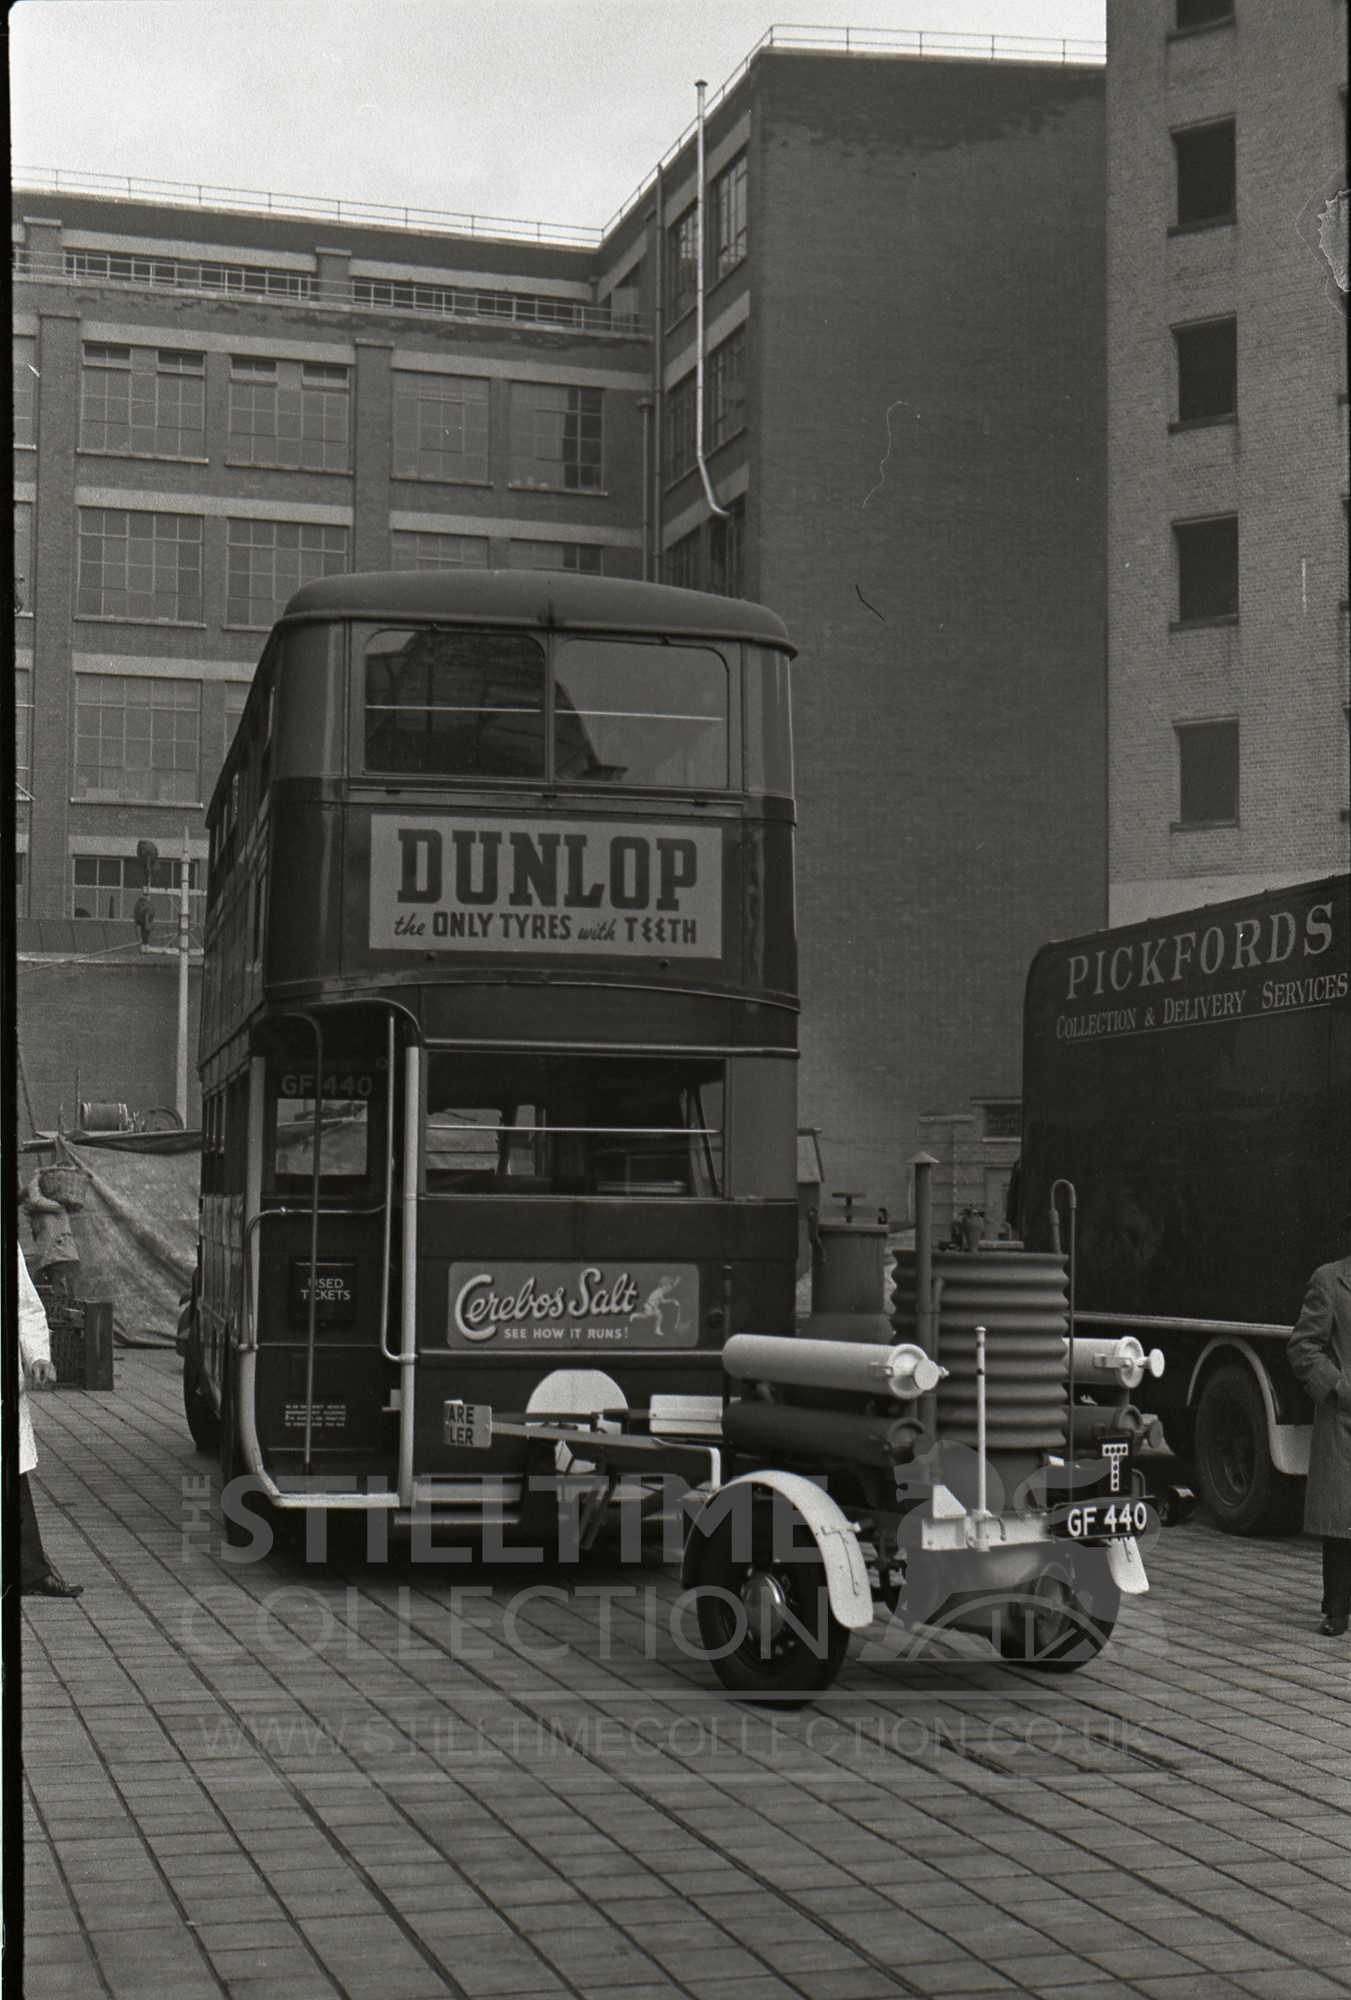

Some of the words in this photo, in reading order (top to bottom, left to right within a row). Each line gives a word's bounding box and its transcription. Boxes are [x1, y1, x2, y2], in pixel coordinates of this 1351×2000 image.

[397, 828, 698, 912] DUNLOP
[394, 913, 427, 937] the
[433, 912, 494, 939] ONLY
[499, 914, 572, 940] TYRES
[577, 920, 617, 942] with
[624, 917, 697, 944] TEETH
[1065, 902, 1334, 1000] PICKFORDS
[1144, 1007, 1156, 1027] &
[1163, 990, 1248, 1025] DELIVERY
[1261, 973, 1349, 1010] SERVICES
[281, 1074, 316, 1095] GF
[322, 1075, 374, 1097] 440
[301, 1289, 351, 1300] TCKETS
[455, 1274, 565, 1340] Cerebos
[568, 1268, 639, 1317] Salt
[504, 1328, 527, 1339] SEE
[533, 1328, 565, 1339] HOW
[570, 1328, 582, 1339] IT
[587, 1327, 630, 1339] RUNS!
[1067, 1506, 1097, 1537] GF
[1104, 1502, 1147, 1533] 440
